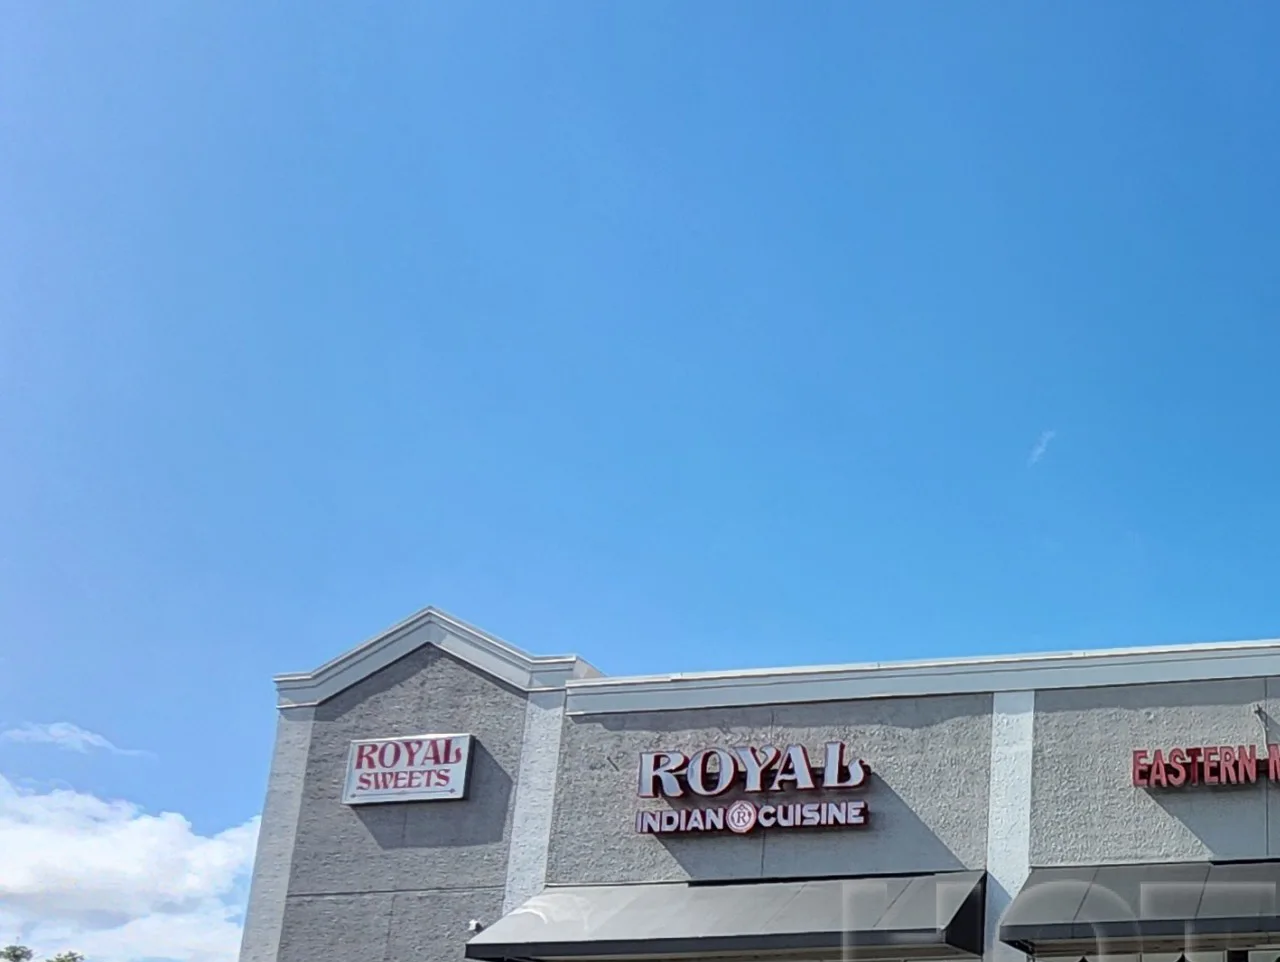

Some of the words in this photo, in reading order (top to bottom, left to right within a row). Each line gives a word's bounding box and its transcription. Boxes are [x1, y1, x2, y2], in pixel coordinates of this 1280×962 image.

[355, 738, 462, 770] ROYAL
[637, 741, 871, 798] ROYAL
[1132, 745, 1258, 788] EASTERN
[355, 768, 451, 791] SWEETS
[636, 807, 724, 833] INDIAN
[757, 800, 867, 828] CUISINE
